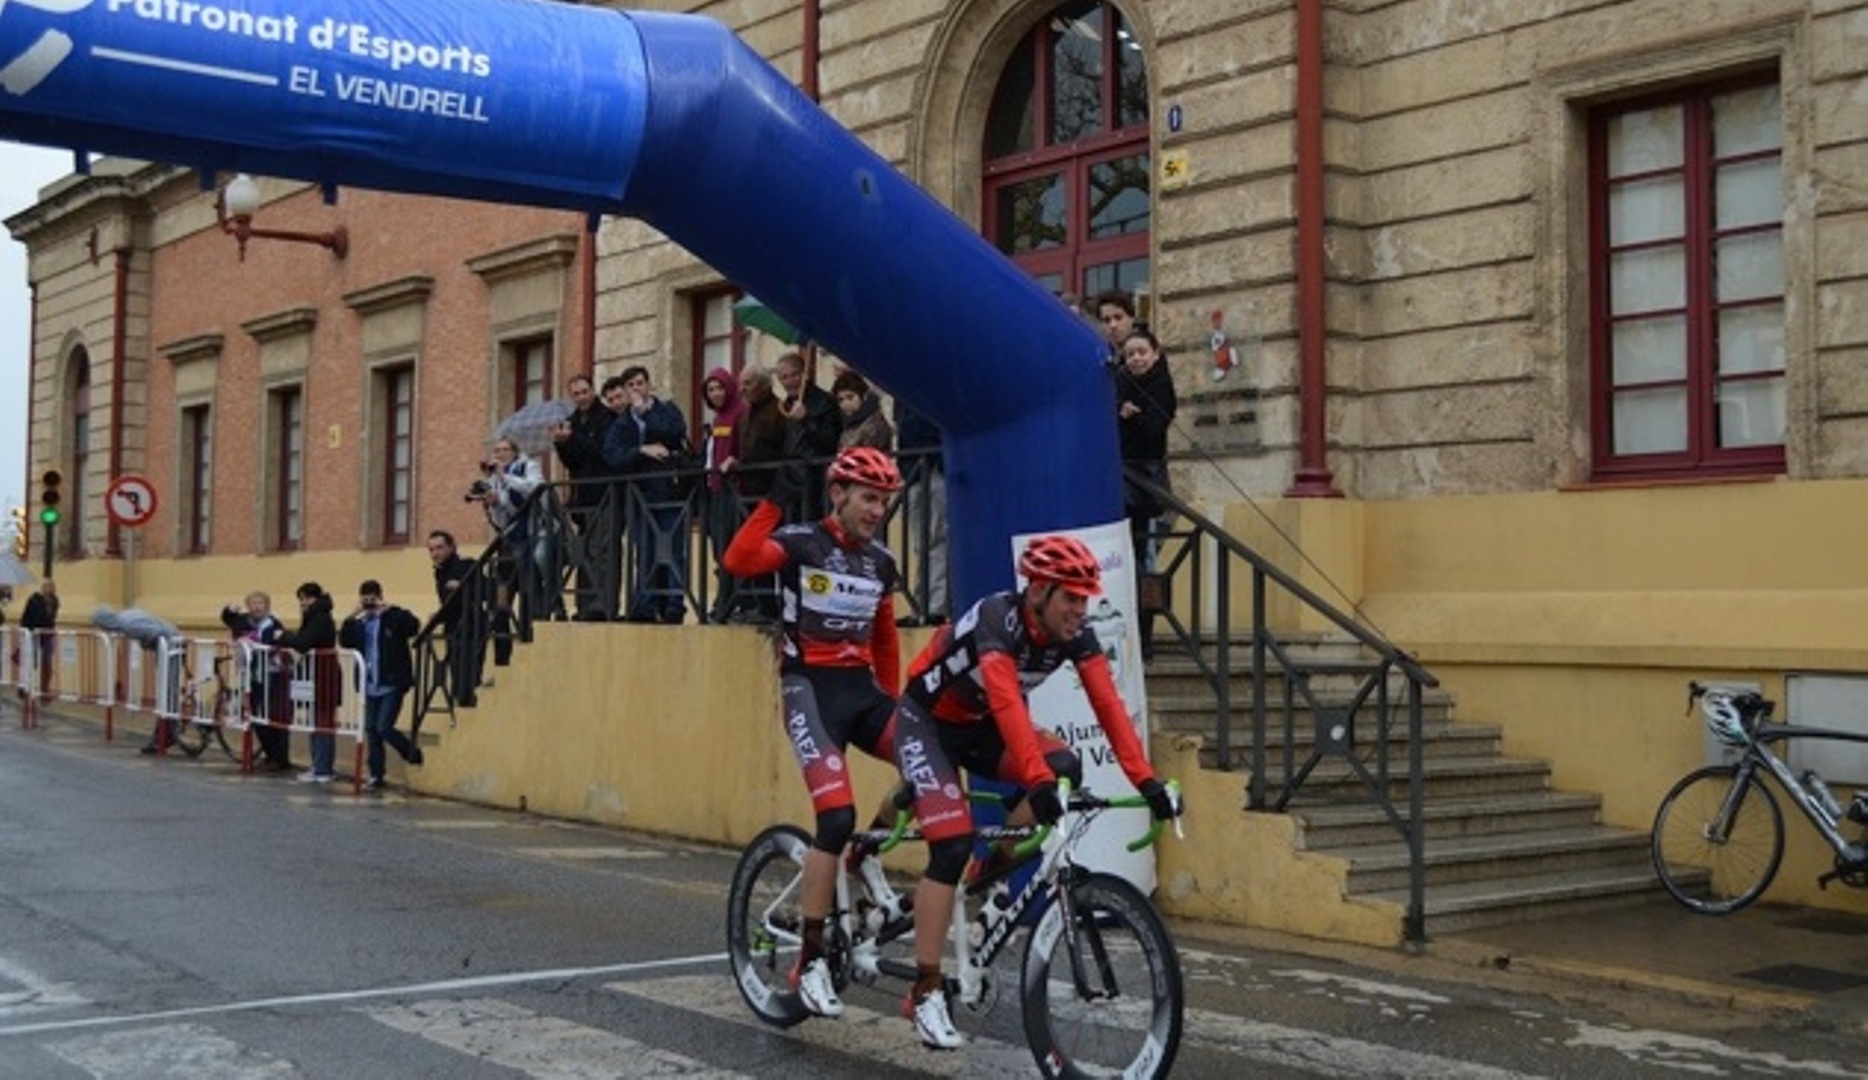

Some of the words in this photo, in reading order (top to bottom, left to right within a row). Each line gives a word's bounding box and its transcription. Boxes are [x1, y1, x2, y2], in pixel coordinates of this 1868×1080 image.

[289, 65, 326, 97] EL
[334, 72, 489, 122] VENDRELL
[788, 712, 821, 766] PAEZ
[902, 740, 941, 796] PAEZ
